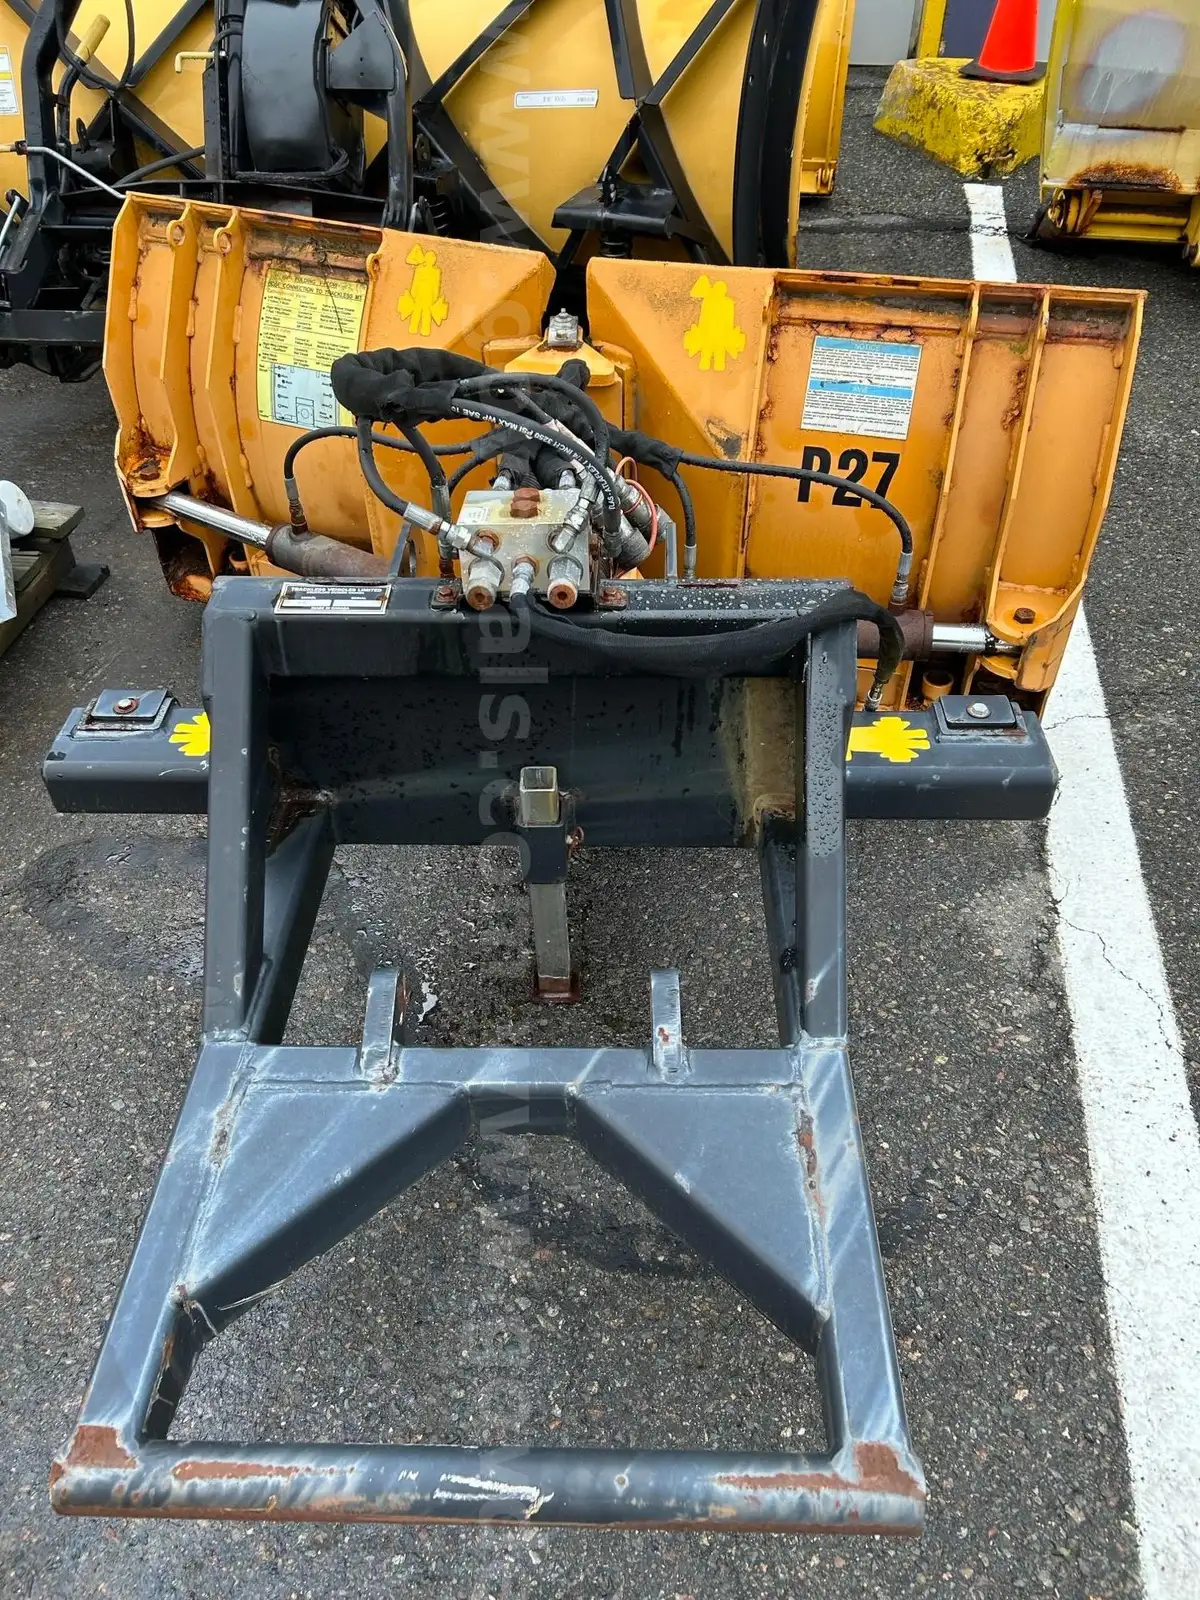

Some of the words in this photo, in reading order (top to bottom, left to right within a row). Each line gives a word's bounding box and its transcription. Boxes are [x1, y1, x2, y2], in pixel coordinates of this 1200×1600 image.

[282, 282, 315, 293] CONNECTION
[462, 408, 481, 419] SAE
[482, 414, 497, 424] WP
[498, 418, 518, 431] MAX
[518, 425, 534, 437] PSI
[533, 432, 554, 444] 3250
[552, 441, 574, 456] INCH
[797, 445, 901, 509] P27
